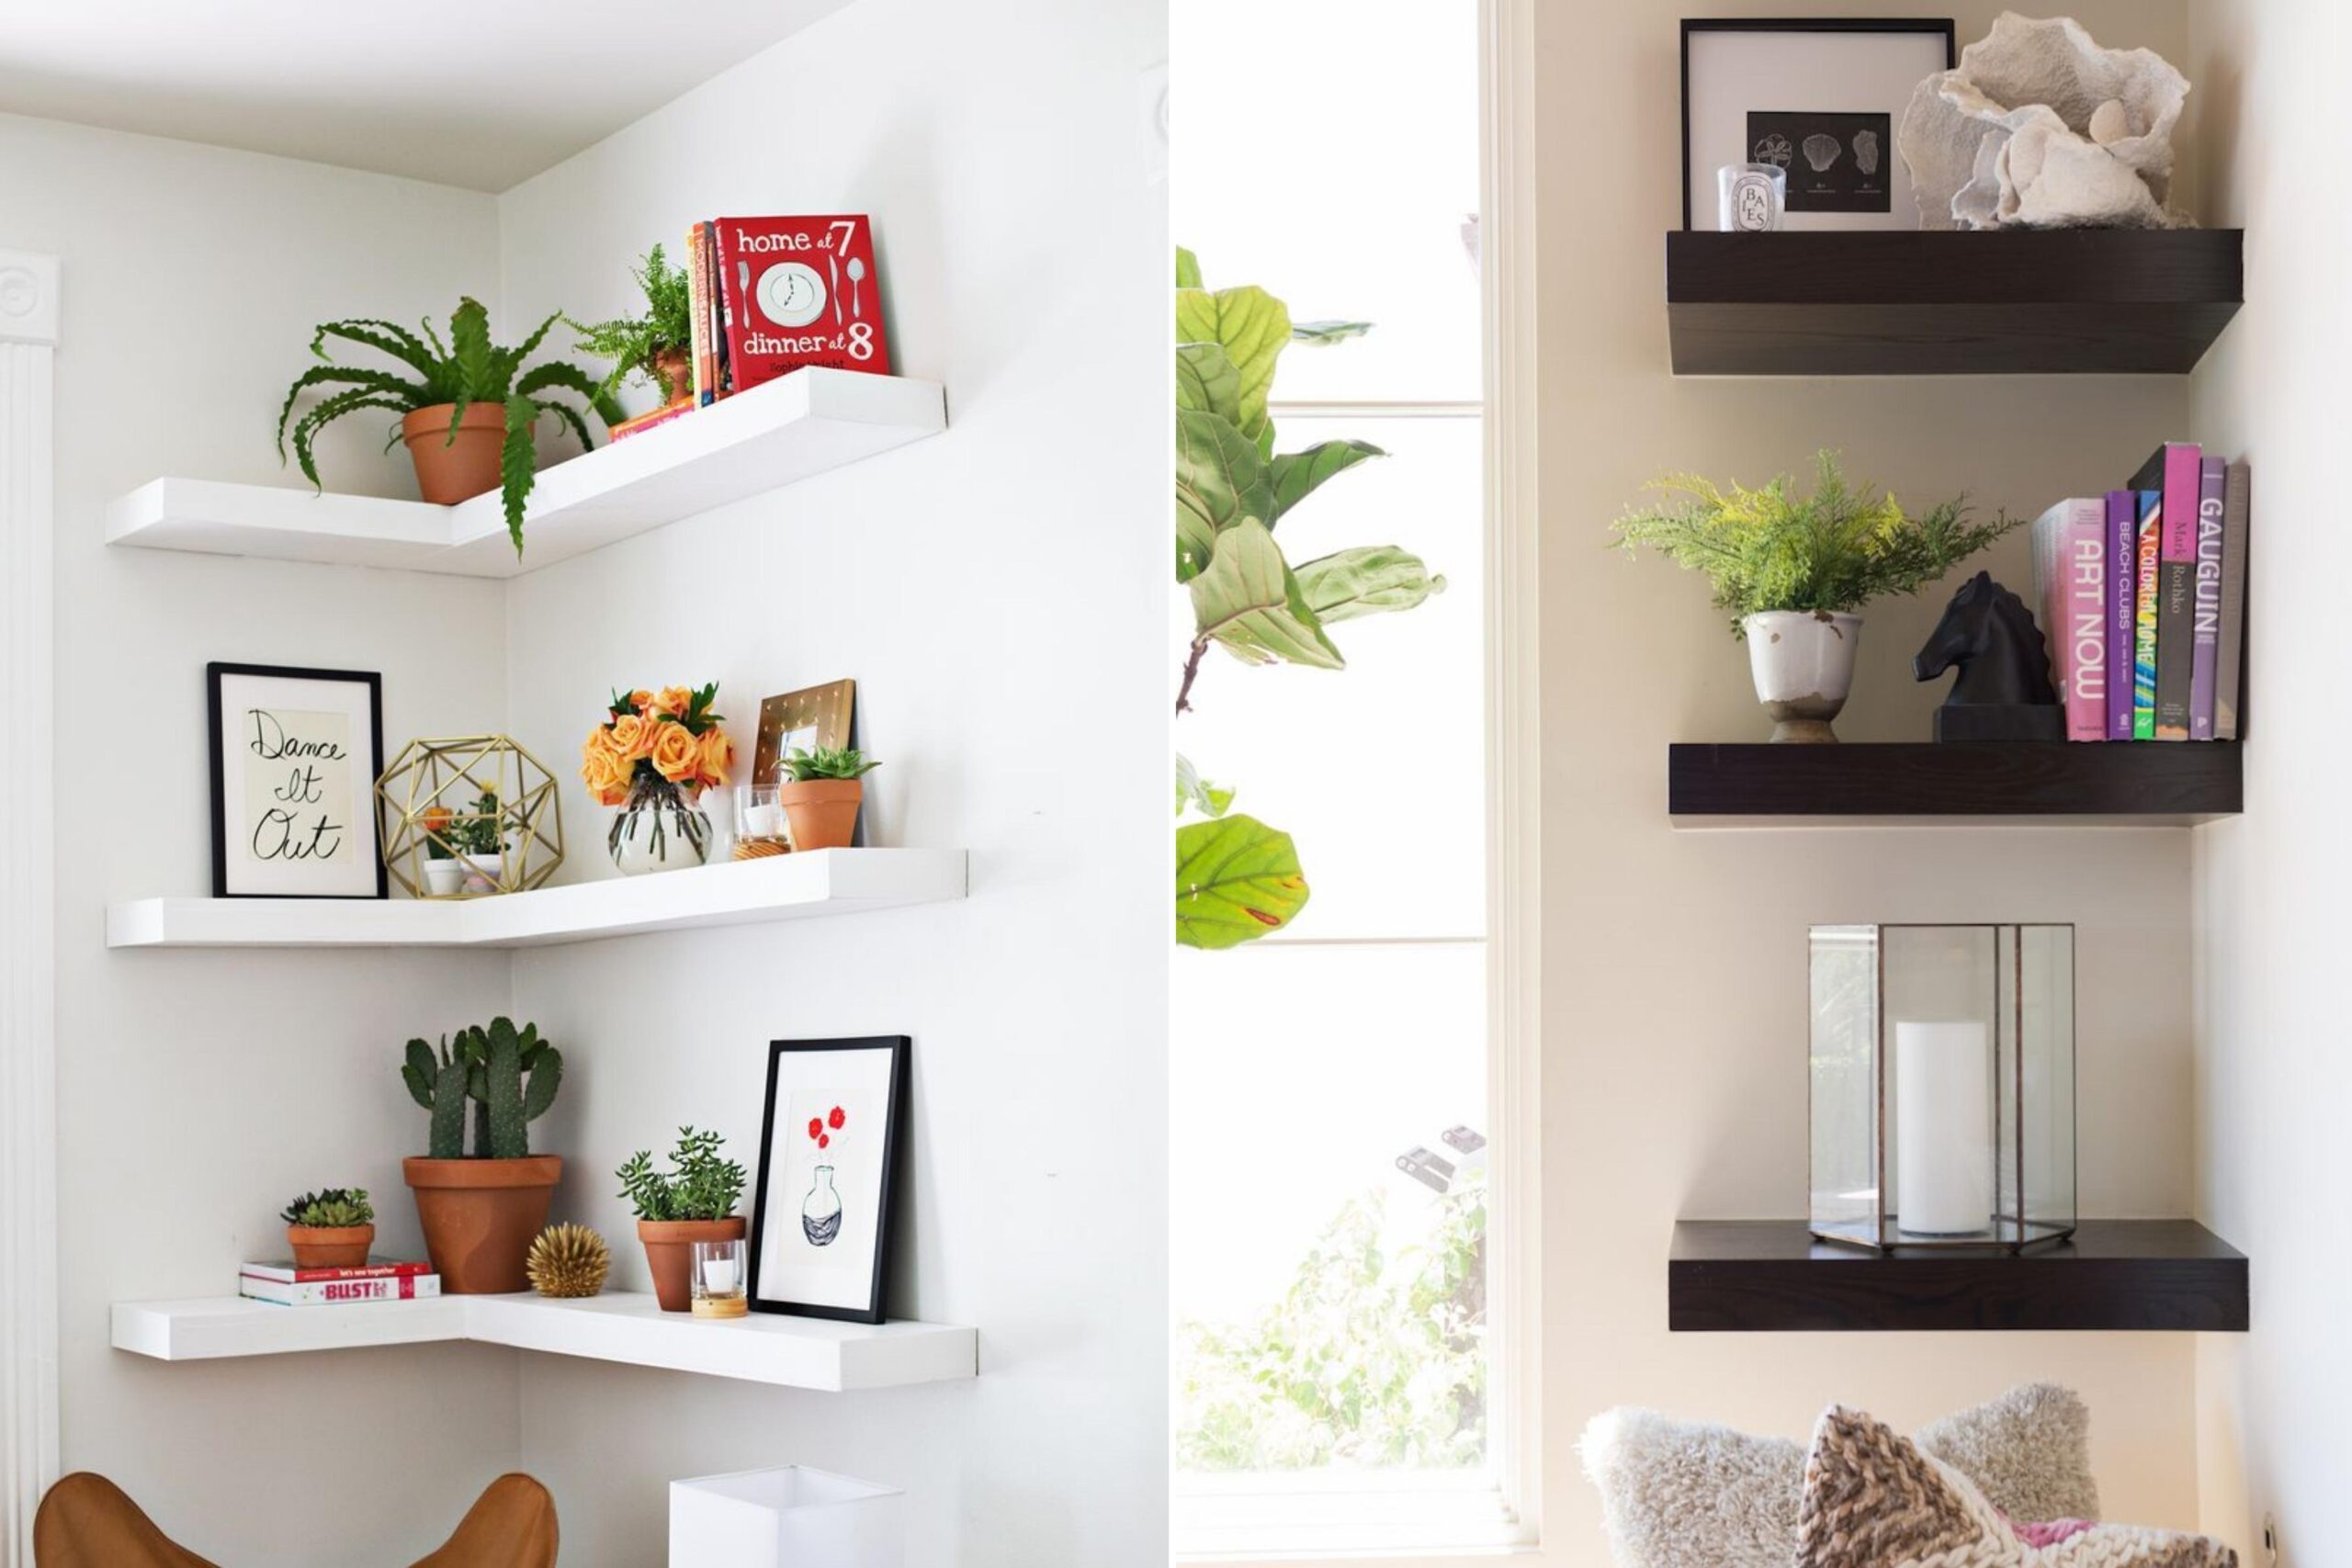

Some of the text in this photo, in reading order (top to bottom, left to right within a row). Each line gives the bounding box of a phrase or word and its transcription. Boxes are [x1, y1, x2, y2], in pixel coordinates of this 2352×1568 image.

[737, 220, 856, 257] home at 7
[743, 321, 874, 361] dinner at 8
[2075, 539, 2105, 606] ART
[2119, 520, 2131, 574] BEACH
[2172, 522, 2188, 615] Mark Rothko
[2194, 497, 2224, 633] GAUGUIN
[2119, 578, 2131, 630] CLUBS
[2136, 533, 2157, 663] A COLORFUL HOME
[2075, 613, 2106, 700] NOW
[248, 708, 347, 761] Dance
[274, 765, 323, 804] It
[253, 807, 344, 861] Out
[324, 1281, 372, 1301] BUST
